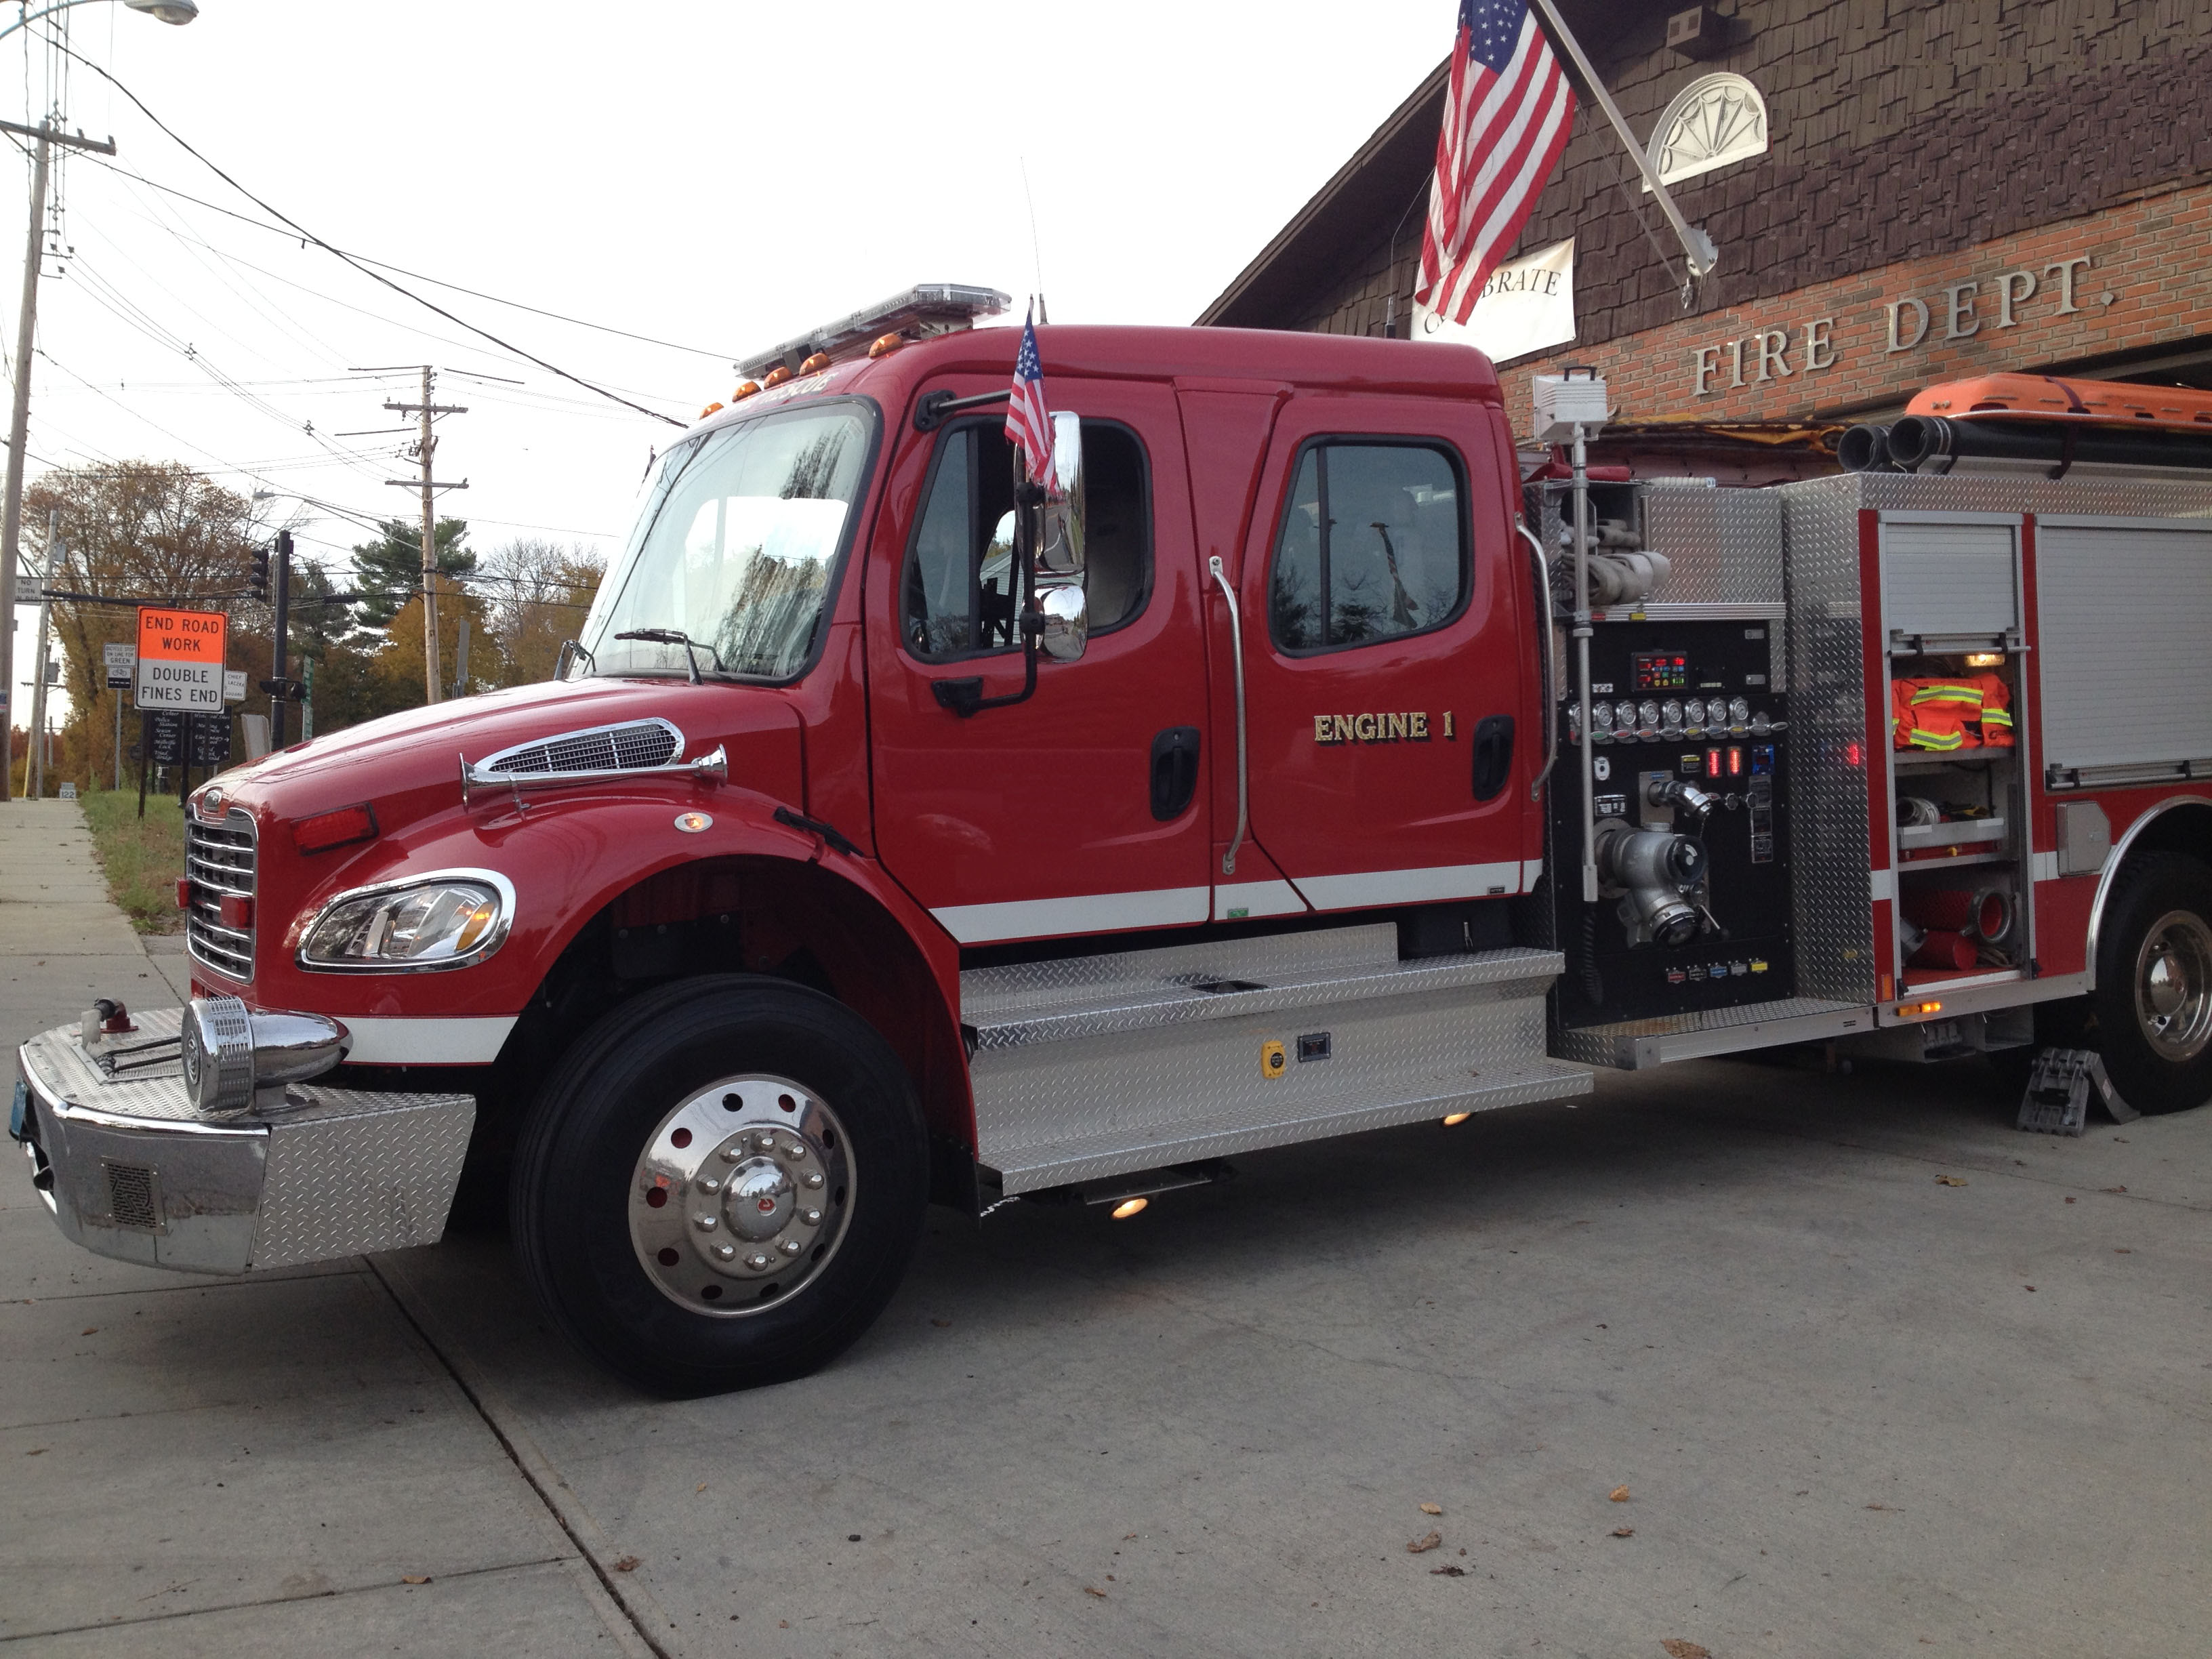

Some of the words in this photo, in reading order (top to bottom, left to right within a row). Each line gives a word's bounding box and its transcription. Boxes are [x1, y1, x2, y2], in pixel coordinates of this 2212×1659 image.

[1424, 268, 1561, 334] CBRATE
[1694, 317, 1835, 396] FIRE
[1884, 255, 2114, 354] DEPT.
[146, 616, 173, 630] END
[182, 619, 219, 634] ROAD
[162, 637, 201, 652] WORK
[152, 667, 208, 683] DOUBLE
[142, 686, 182, 701] FINES
[190, 689, 217, 703] END
[1313, 712, 1428, 742] ENGINE
[1442, 710, 1454, 737] 1
